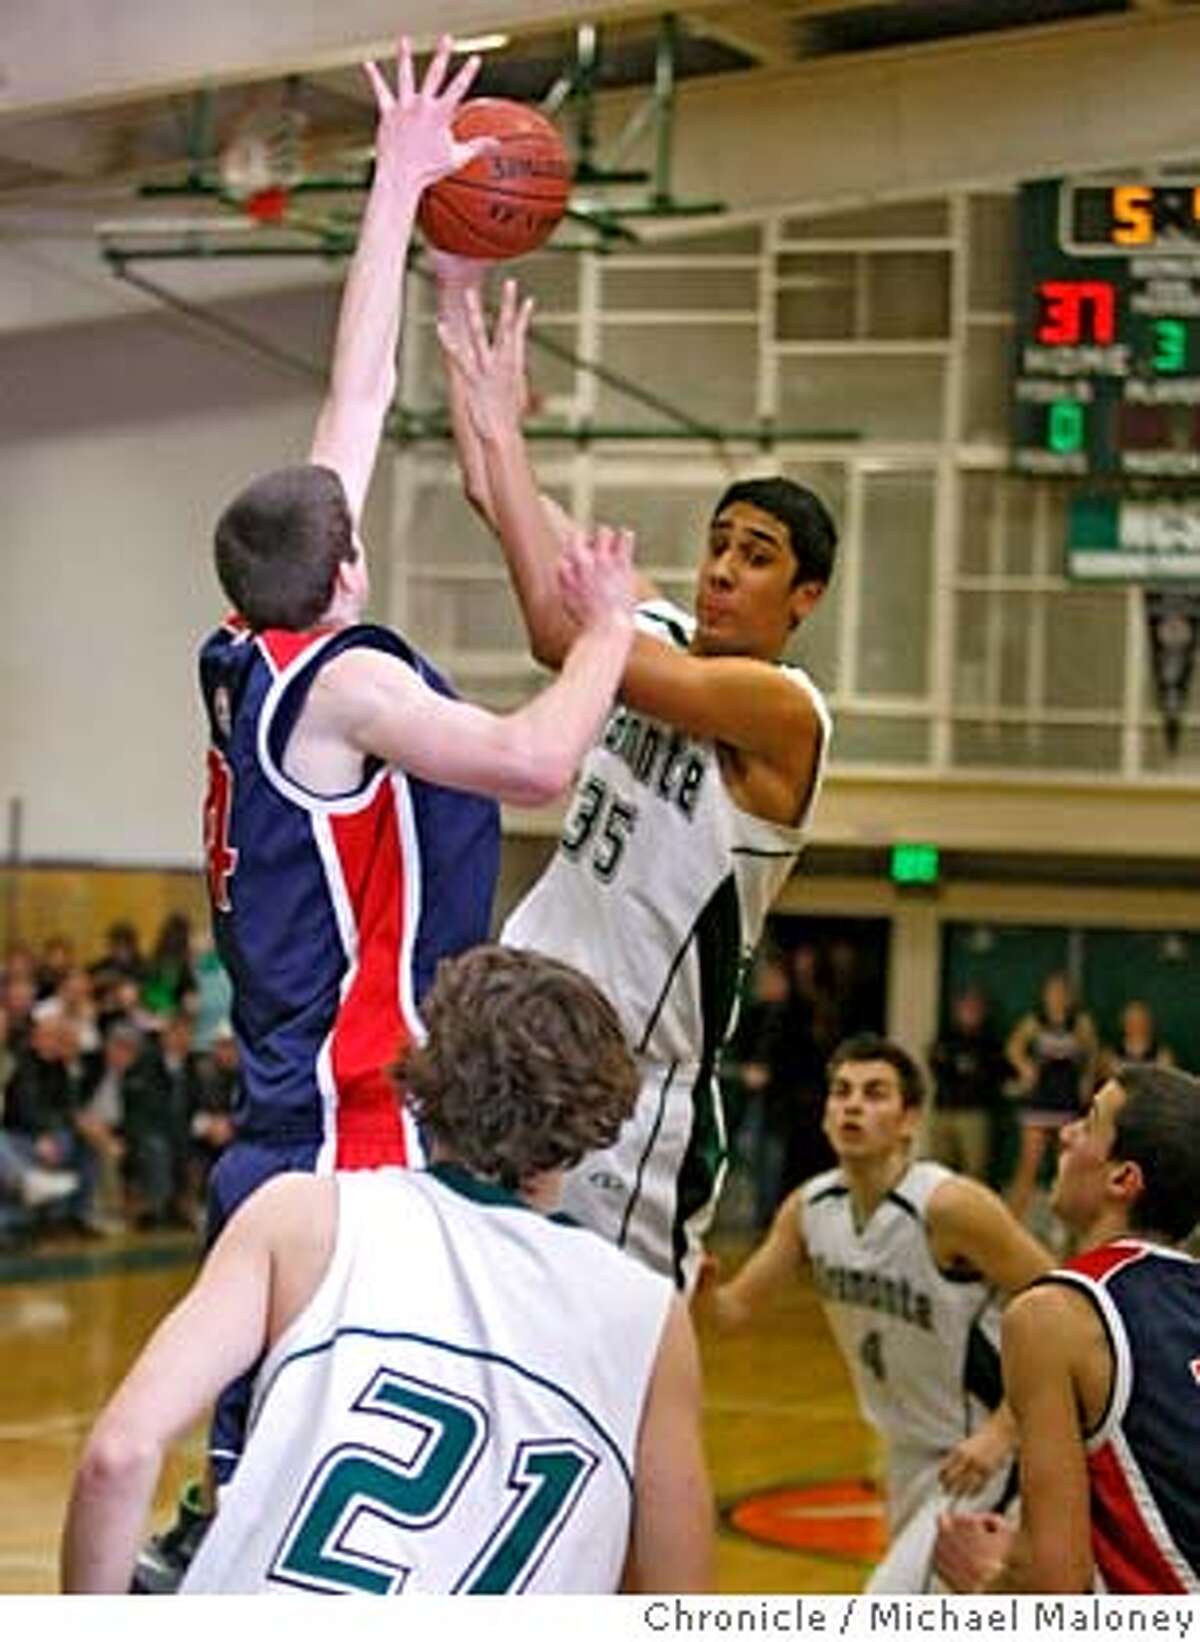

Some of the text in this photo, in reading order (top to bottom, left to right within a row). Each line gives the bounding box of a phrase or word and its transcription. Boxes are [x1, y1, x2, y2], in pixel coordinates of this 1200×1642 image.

[1038, 281, 1115, 344] 37
[1153, 320, 1187, 371] 3
[1048, 398, 1083, 453] 0
[562, 774, 638, 884] 35
[861, 1329, 885, 1381] 4
[264, 1366, 602, 1595] 21
